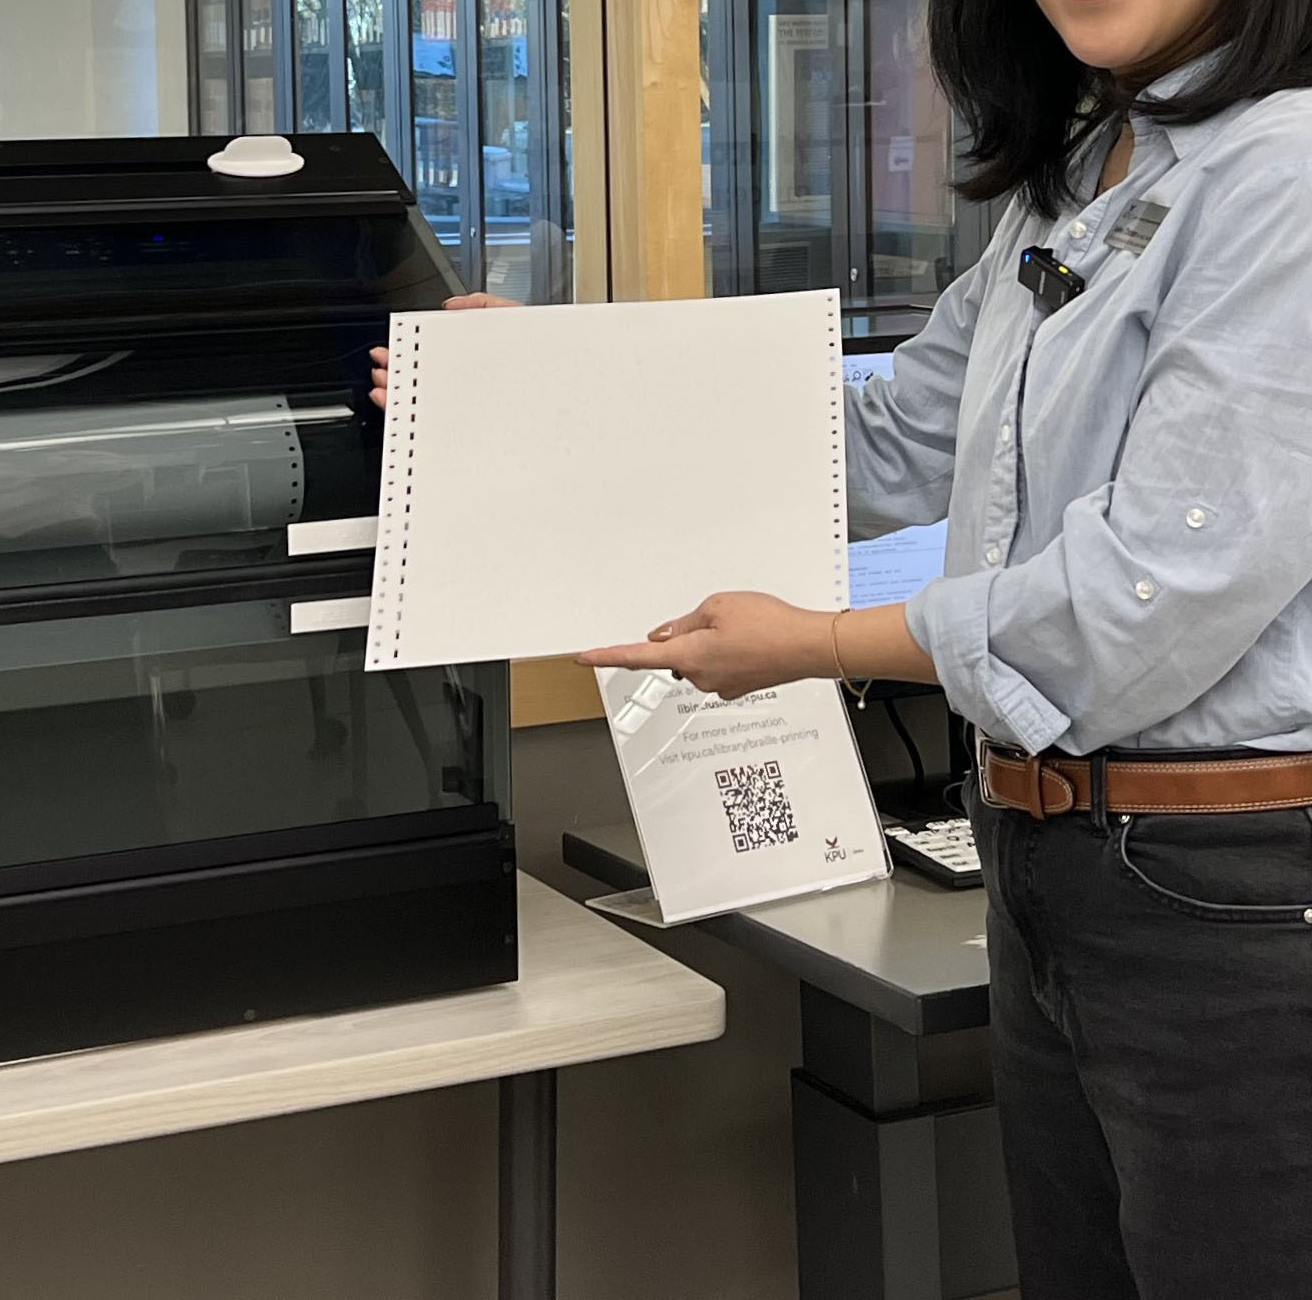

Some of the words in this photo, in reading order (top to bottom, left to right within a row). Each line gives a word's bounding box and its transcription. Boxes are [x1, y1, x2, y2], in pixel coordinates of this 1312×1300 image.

[683, 731, 700, 742] For
[702, 727, 727, 739] more
[825, 850, 846, 863] KPU
